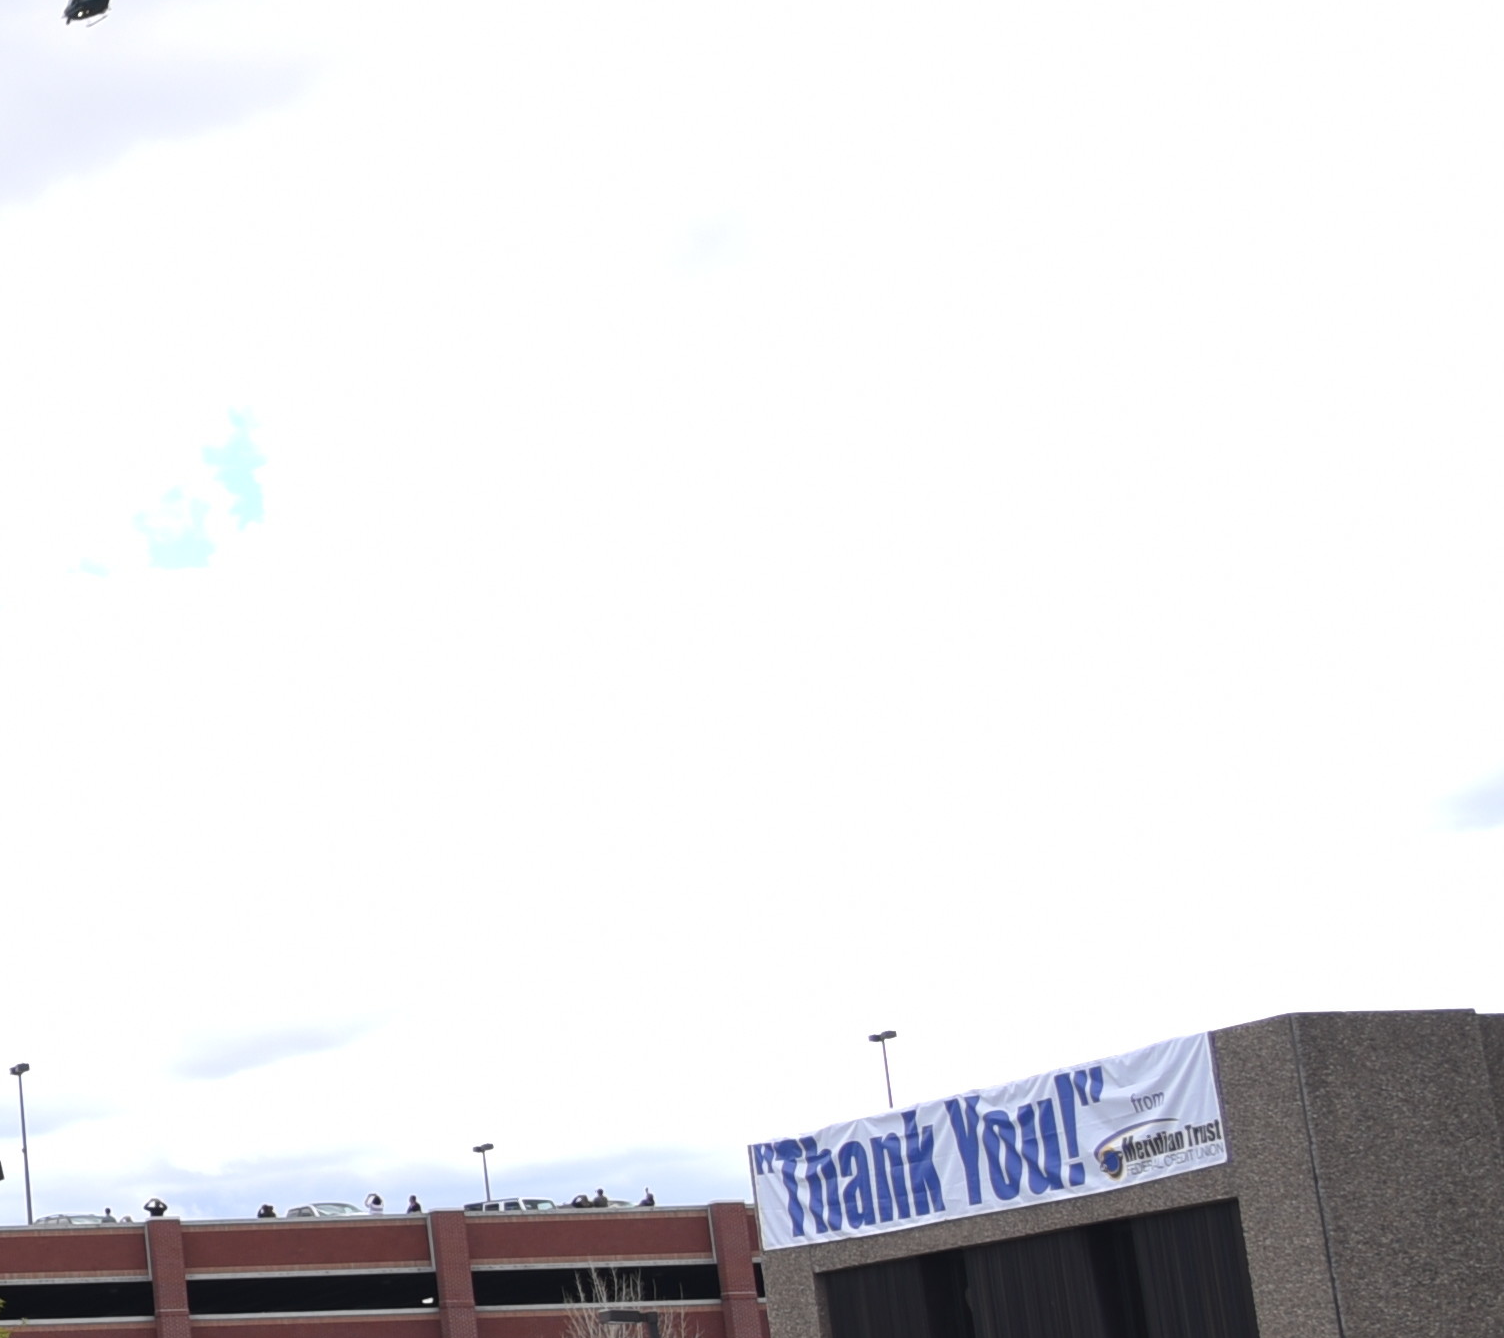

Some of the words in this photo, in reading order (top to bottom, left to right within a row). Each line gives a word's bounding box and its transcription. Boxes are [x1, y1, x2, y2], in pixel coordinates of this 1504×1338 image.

[1130, 1091, 1165, 1113] from
[1122, 1130, 1185, 1163] Meridian
[1185, 1119, 1222, 1148] Trust
[1127, 1157, 1164, 1175] FEDERAL
[1164, 1150, 1195, 1167] CREDIT
[1196, 1142, 1224, 1159] UNION
